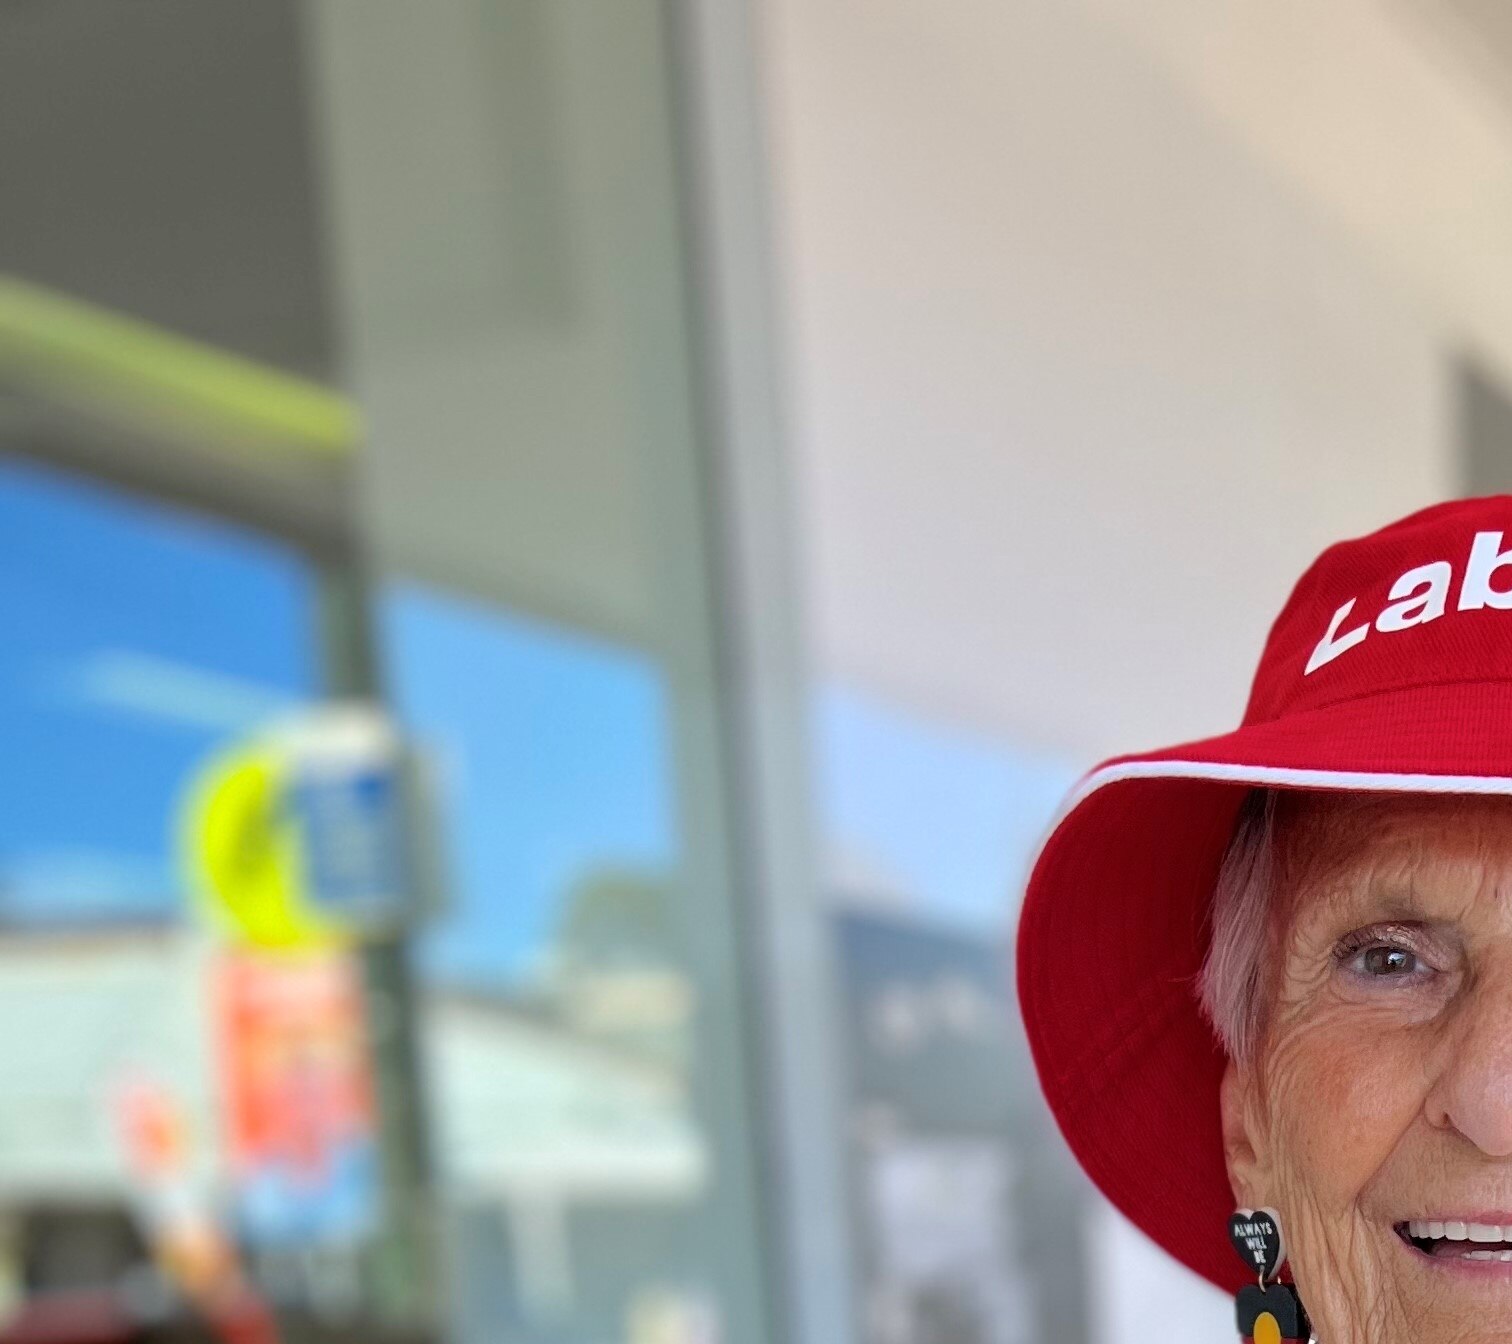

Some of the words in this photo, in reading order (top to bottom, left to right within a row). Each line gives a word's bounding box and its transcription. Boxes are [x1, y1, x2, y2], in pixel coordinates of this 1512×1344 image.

[1234, 1222, 1273, 1236] ALWAYS
[1246, 1237, 1267, 1250] WILL
[1253, 1250, 1266, 1264] BE
